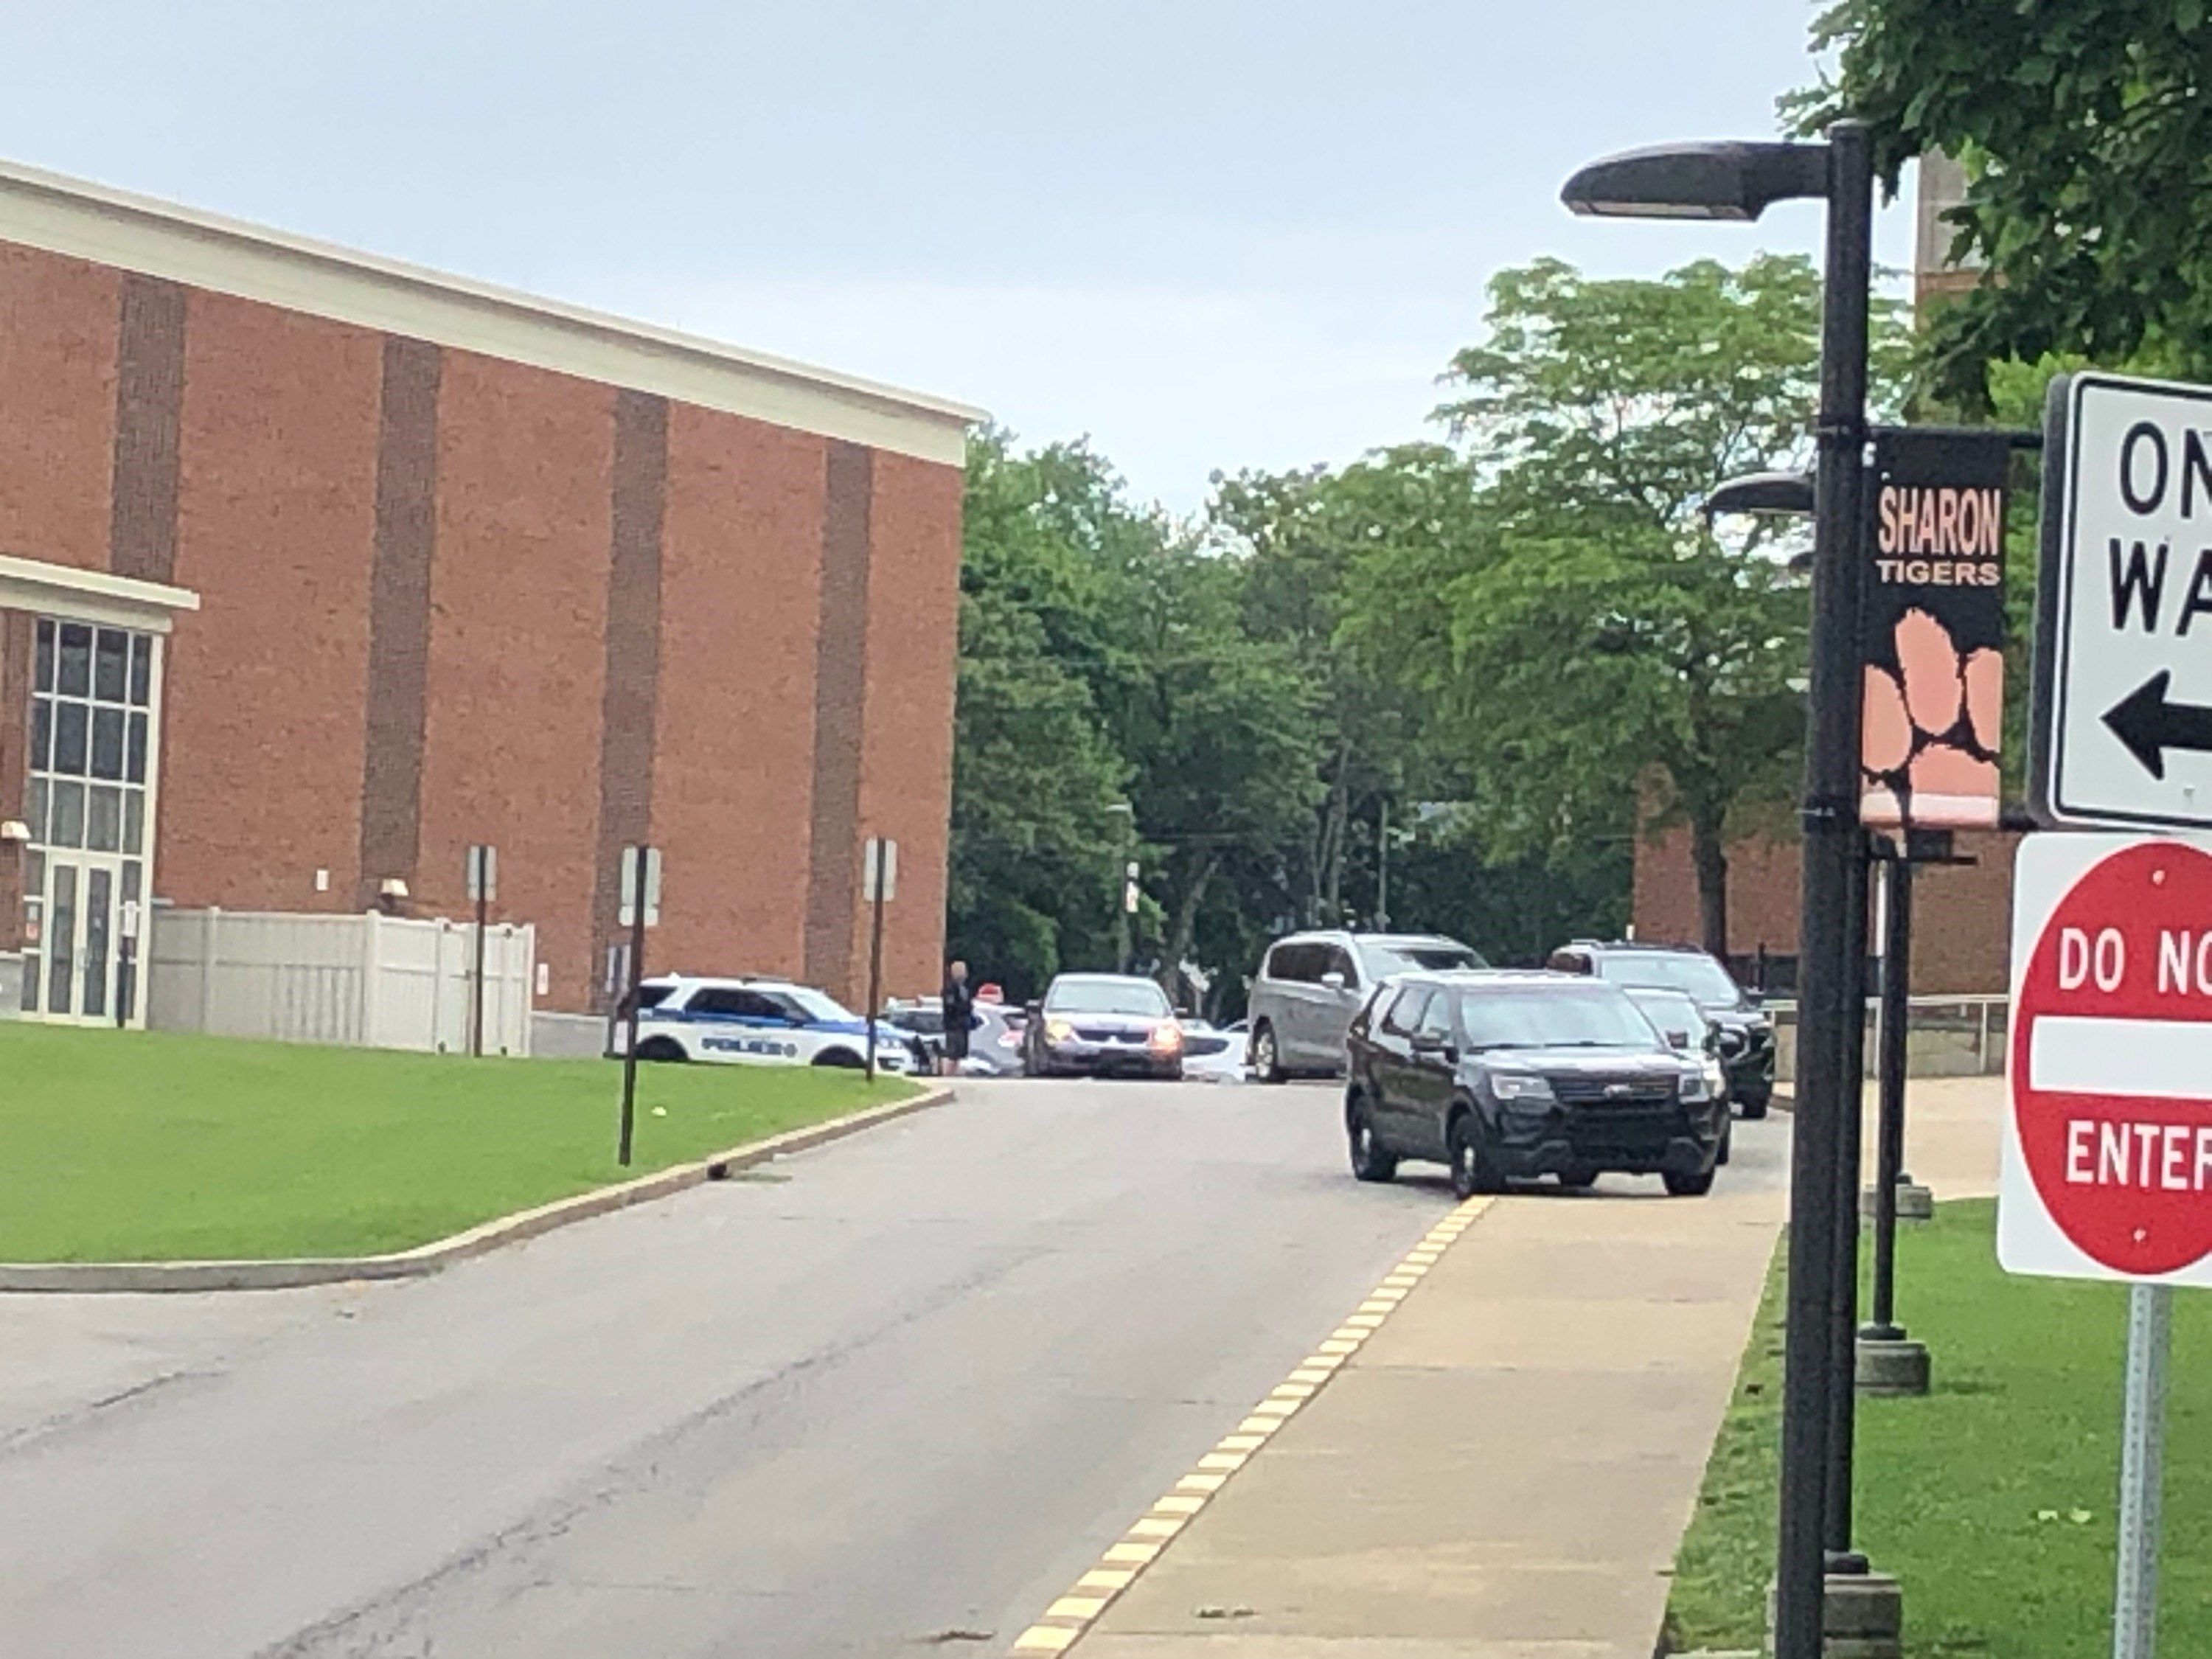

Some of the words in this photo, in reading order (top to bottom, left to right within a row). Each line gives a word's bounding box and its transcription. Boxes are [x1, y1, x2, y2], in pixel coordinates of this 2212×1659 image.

[1879, 486, 2001, 556] SHARON
[1875, 560, 2000, 586] TIGERS
[2059, 928, 2124, 992] DO
